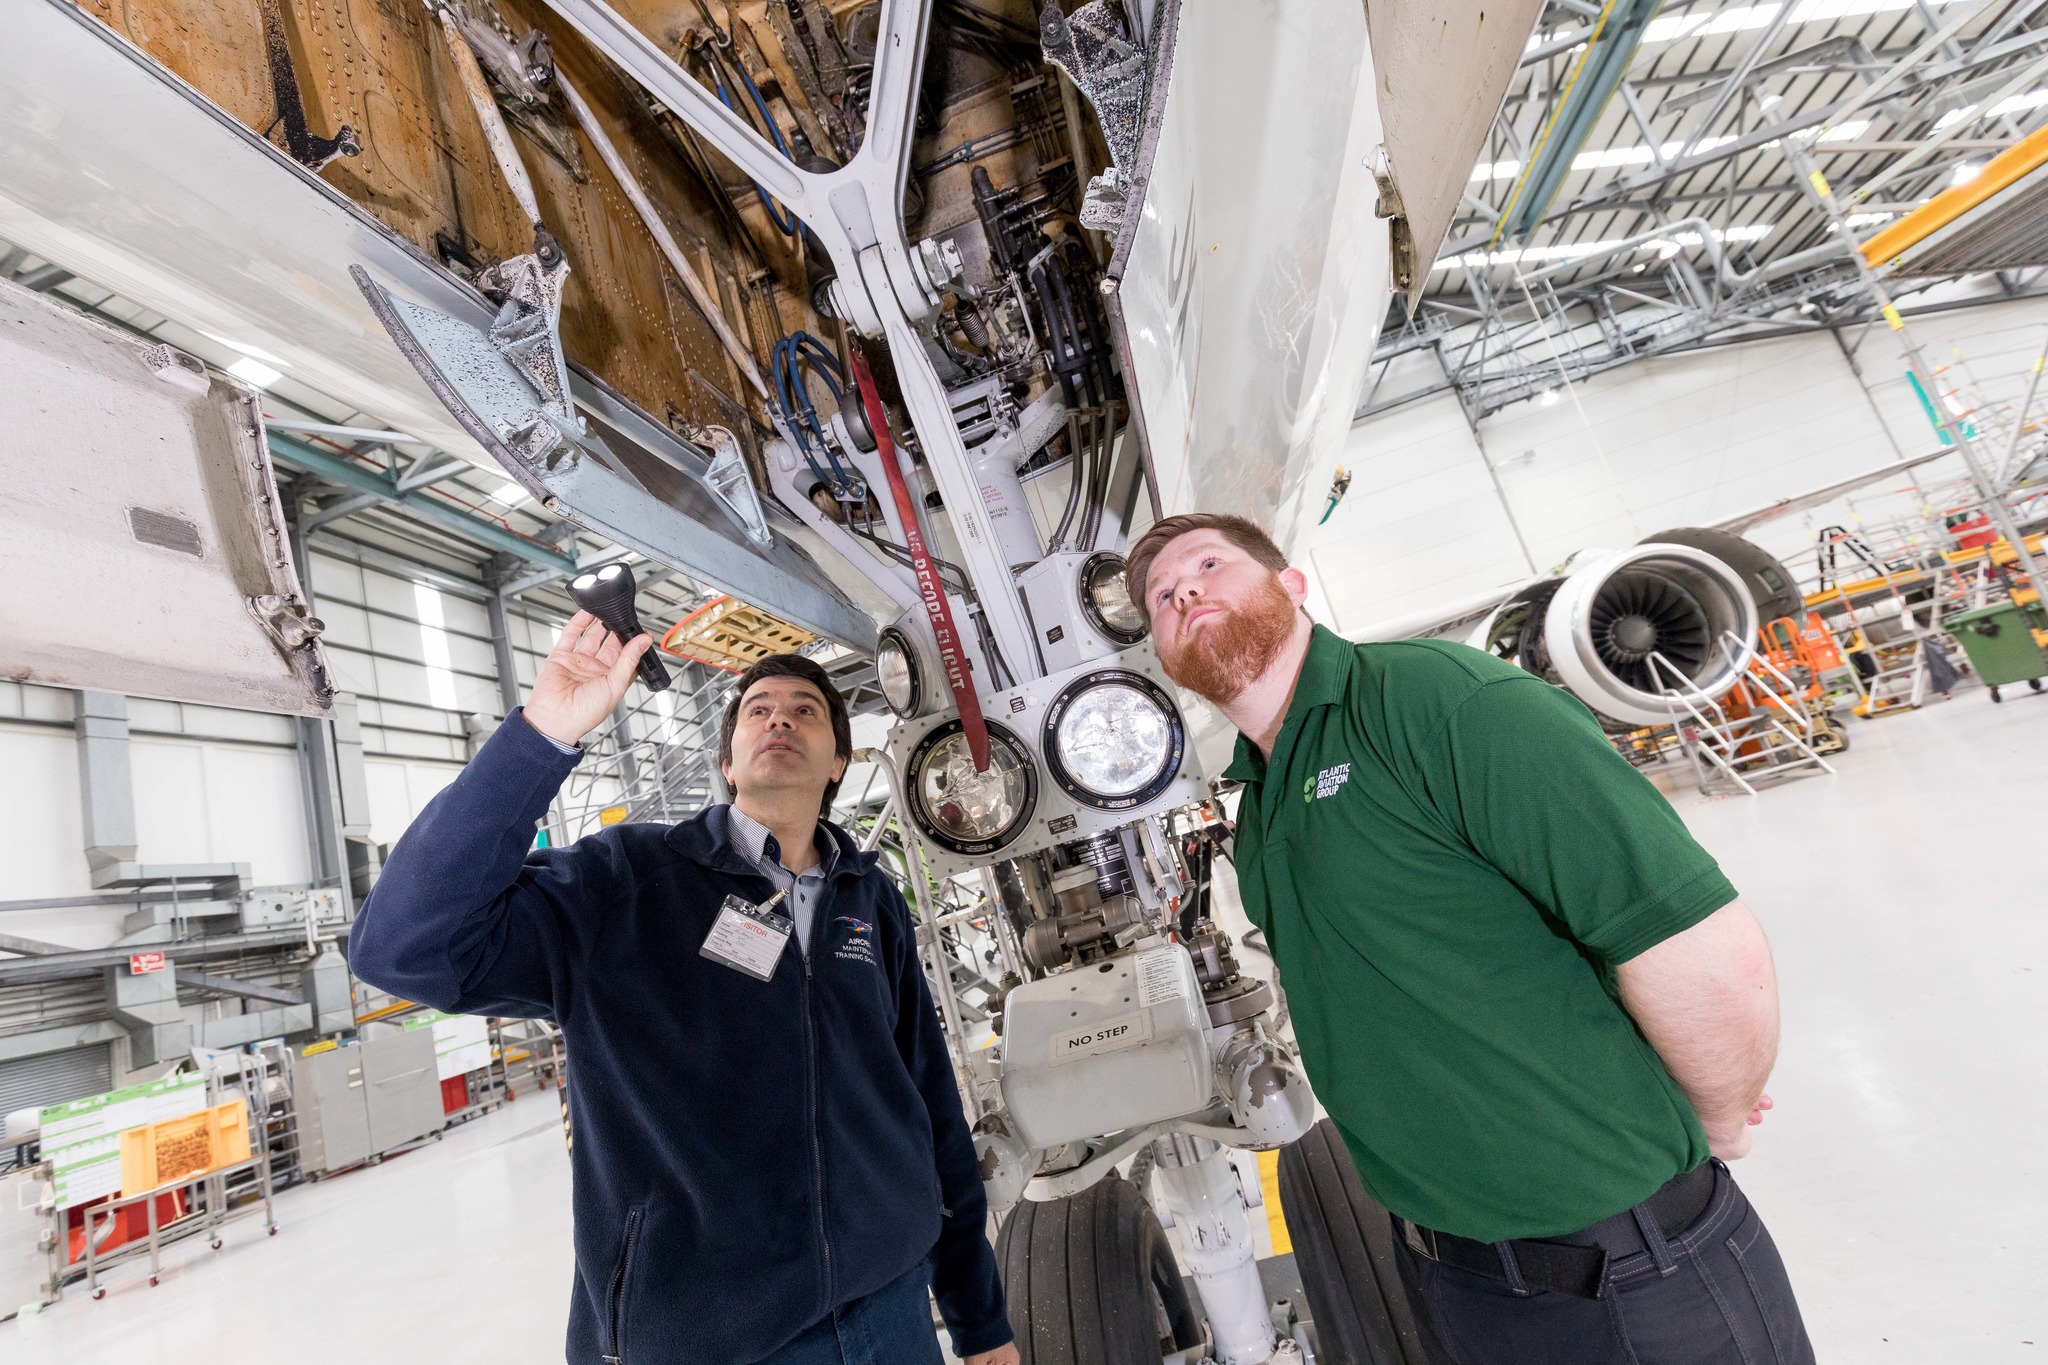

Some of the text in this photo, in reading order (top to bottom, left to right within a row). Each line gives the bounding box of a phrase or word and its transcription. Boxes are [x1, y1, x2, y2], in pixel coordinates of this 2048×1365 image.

[1317, 763, 1351, 781] ATLANTIC
[1316, 772, 1349, 790] AVIATION
[1316, 785, 1340, 799] GROUP
[1090, 837, 1112, 848] COMPANY
[834, 952, 864, 961] TRAINING
[1069, 1025, 1128, 1049] NO STEP
